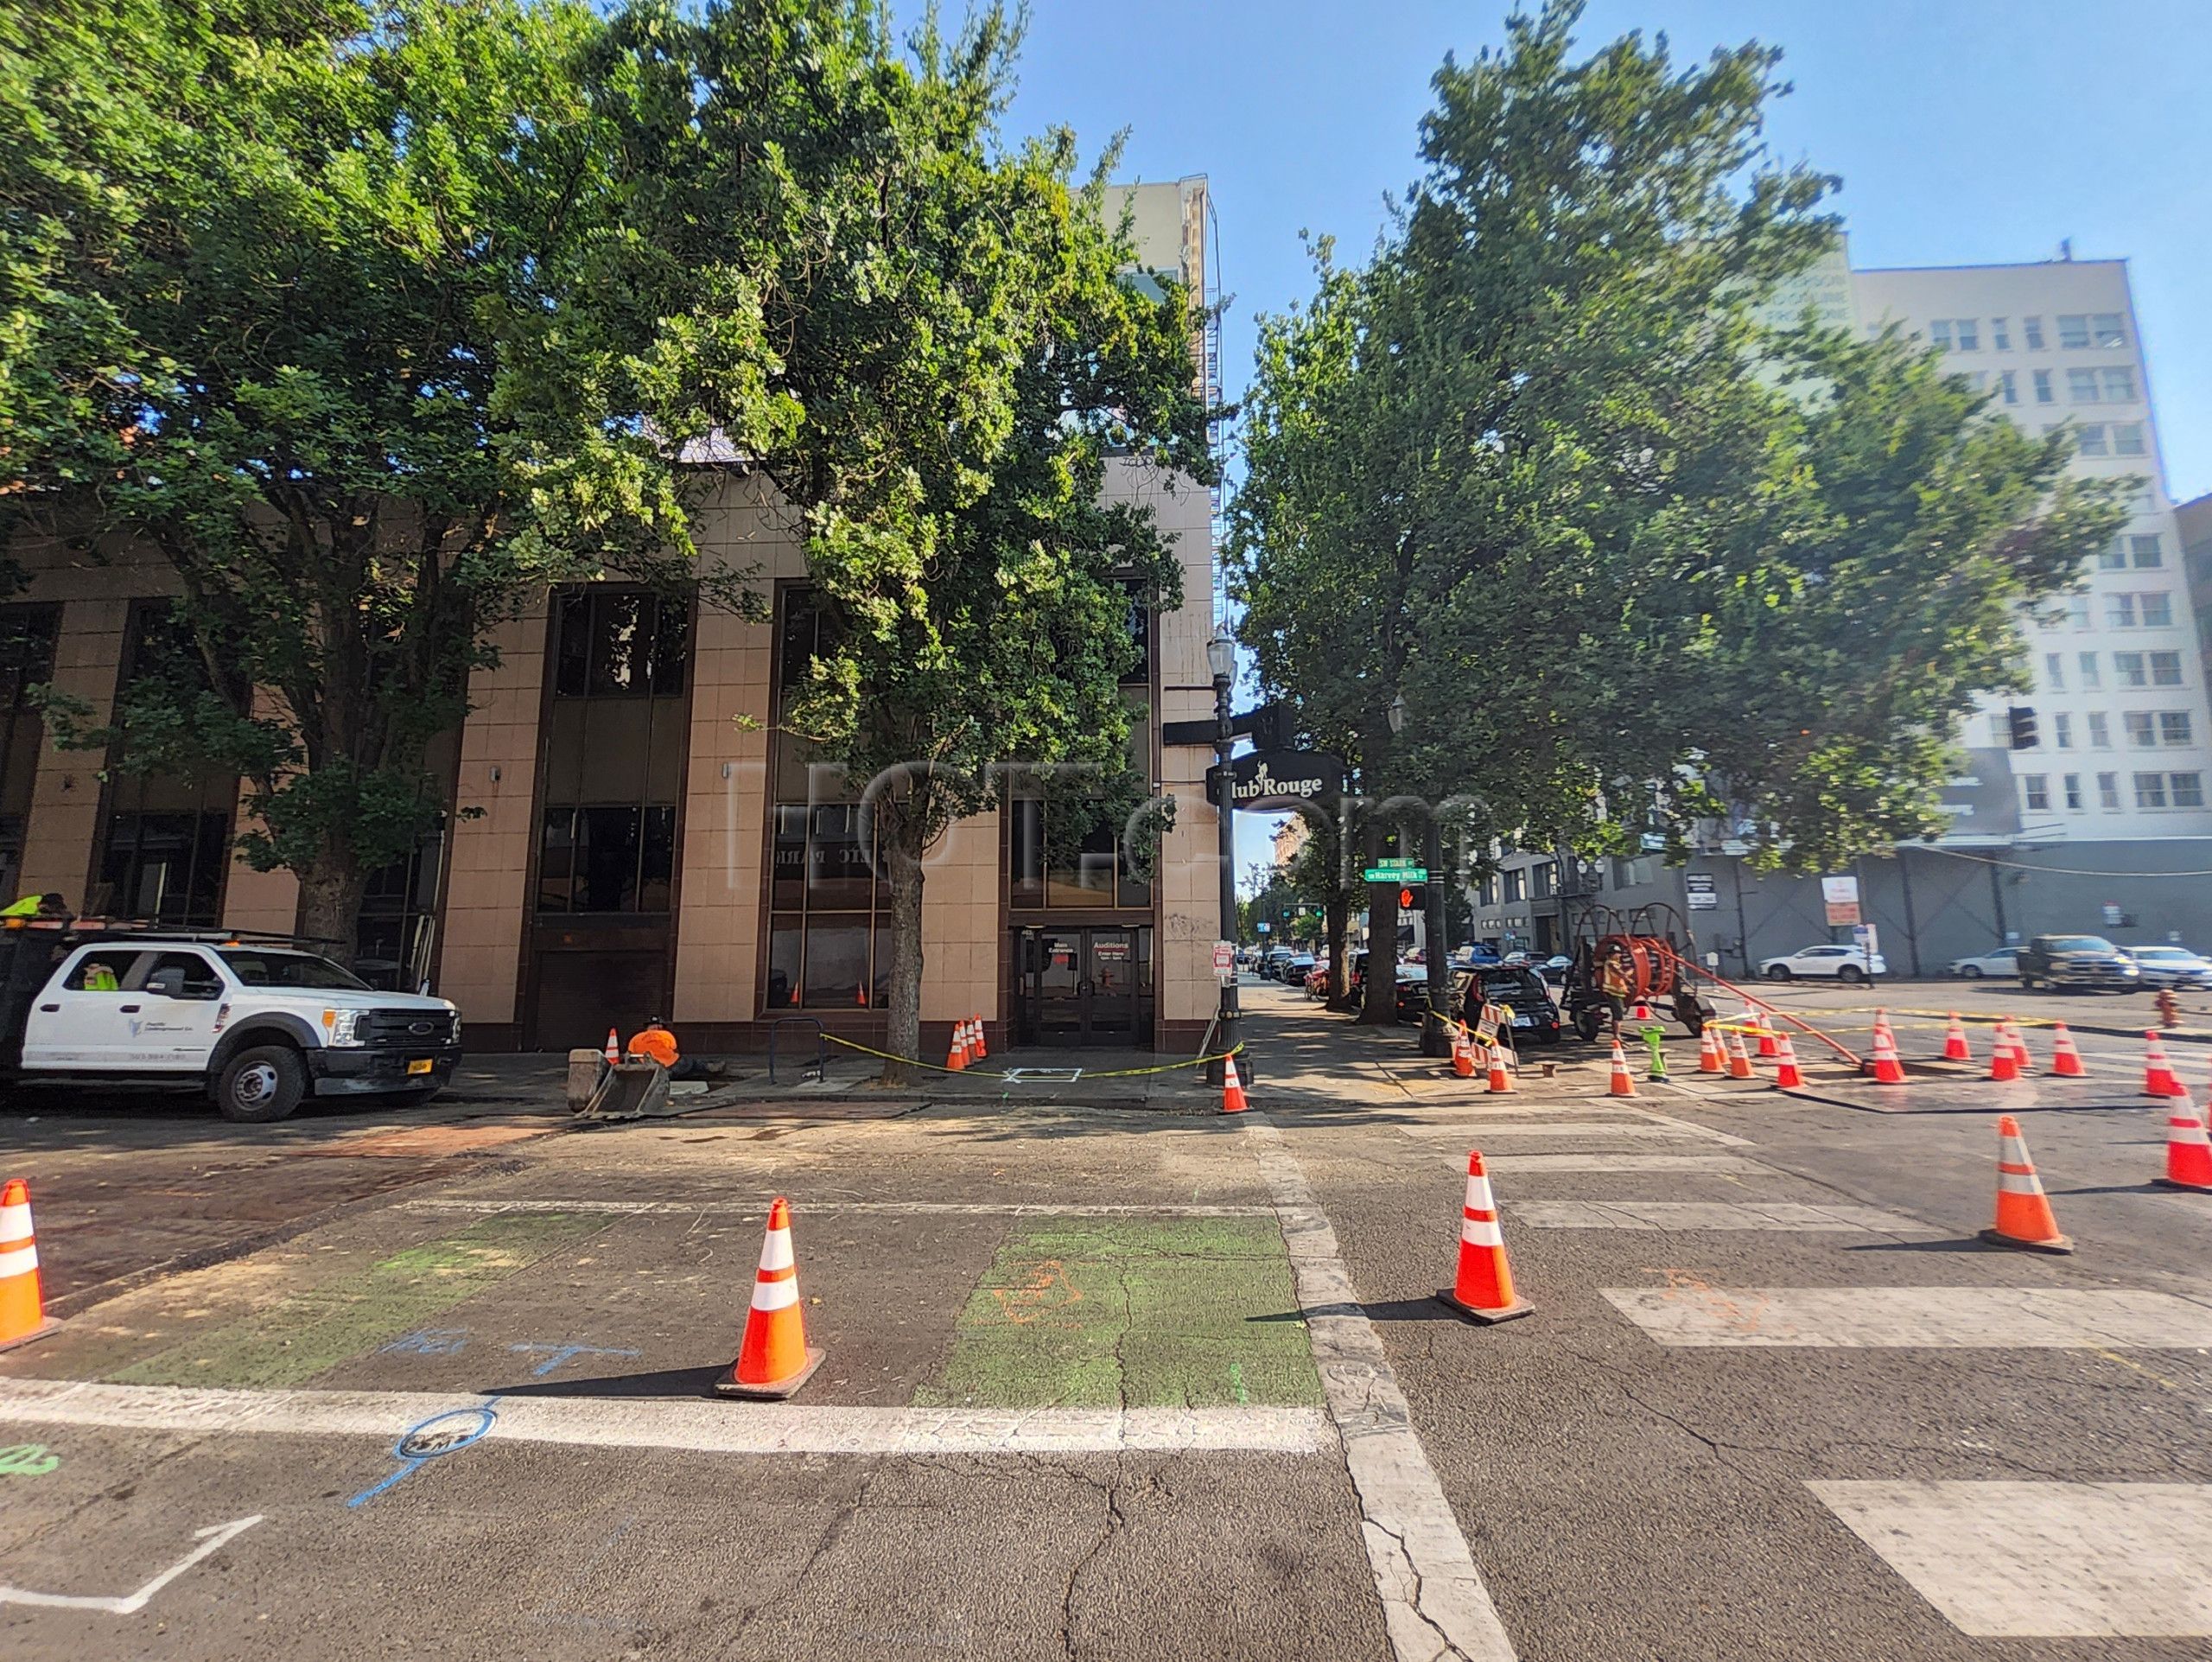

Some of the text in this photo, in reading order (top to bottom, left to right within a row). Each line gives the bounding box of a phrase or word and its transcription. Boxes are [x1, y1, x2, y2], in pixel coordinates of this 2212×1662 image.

[1217, 778, 1323, 799] lub Rouge
[1375, 871, 1401, 881] Harvey
